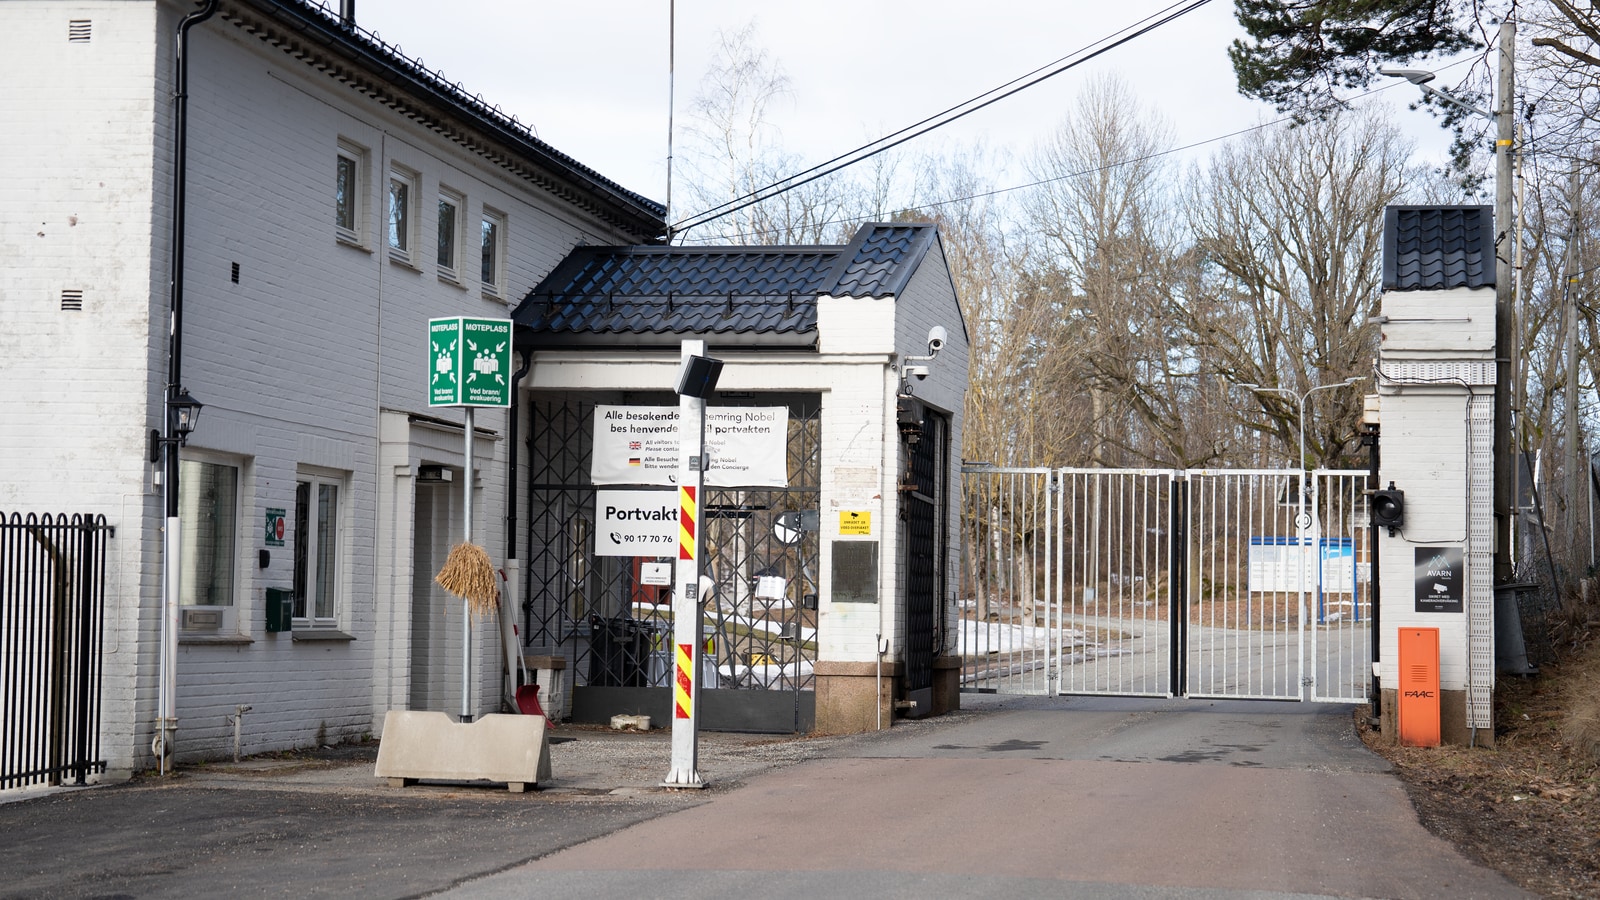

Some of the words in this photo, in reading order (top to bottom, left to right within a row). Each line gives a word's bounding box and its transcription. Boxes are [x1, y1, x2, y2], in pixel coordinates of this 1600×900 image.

[431, 323, 458, 332] MØTEPLASS
[465, 323, 508, 333] MØTEPLASS
[470, 395, 502, 404] evakuering
[604, 410, 623, 420] Alle
[626, 411, 680, 420] besøkende
[705, 412, 742, 424] emring
[746, 412, 775, 422] Nobel
[610, 424, 627, 432] bes
[630, 424, 678, 433] henvende
[715, 425, 770, 436] portvakten
[606, 506, 678, 521] Portvakt
[624, 534, 634, 542] 90
[1404, 690, 1434, 698] FAAC
